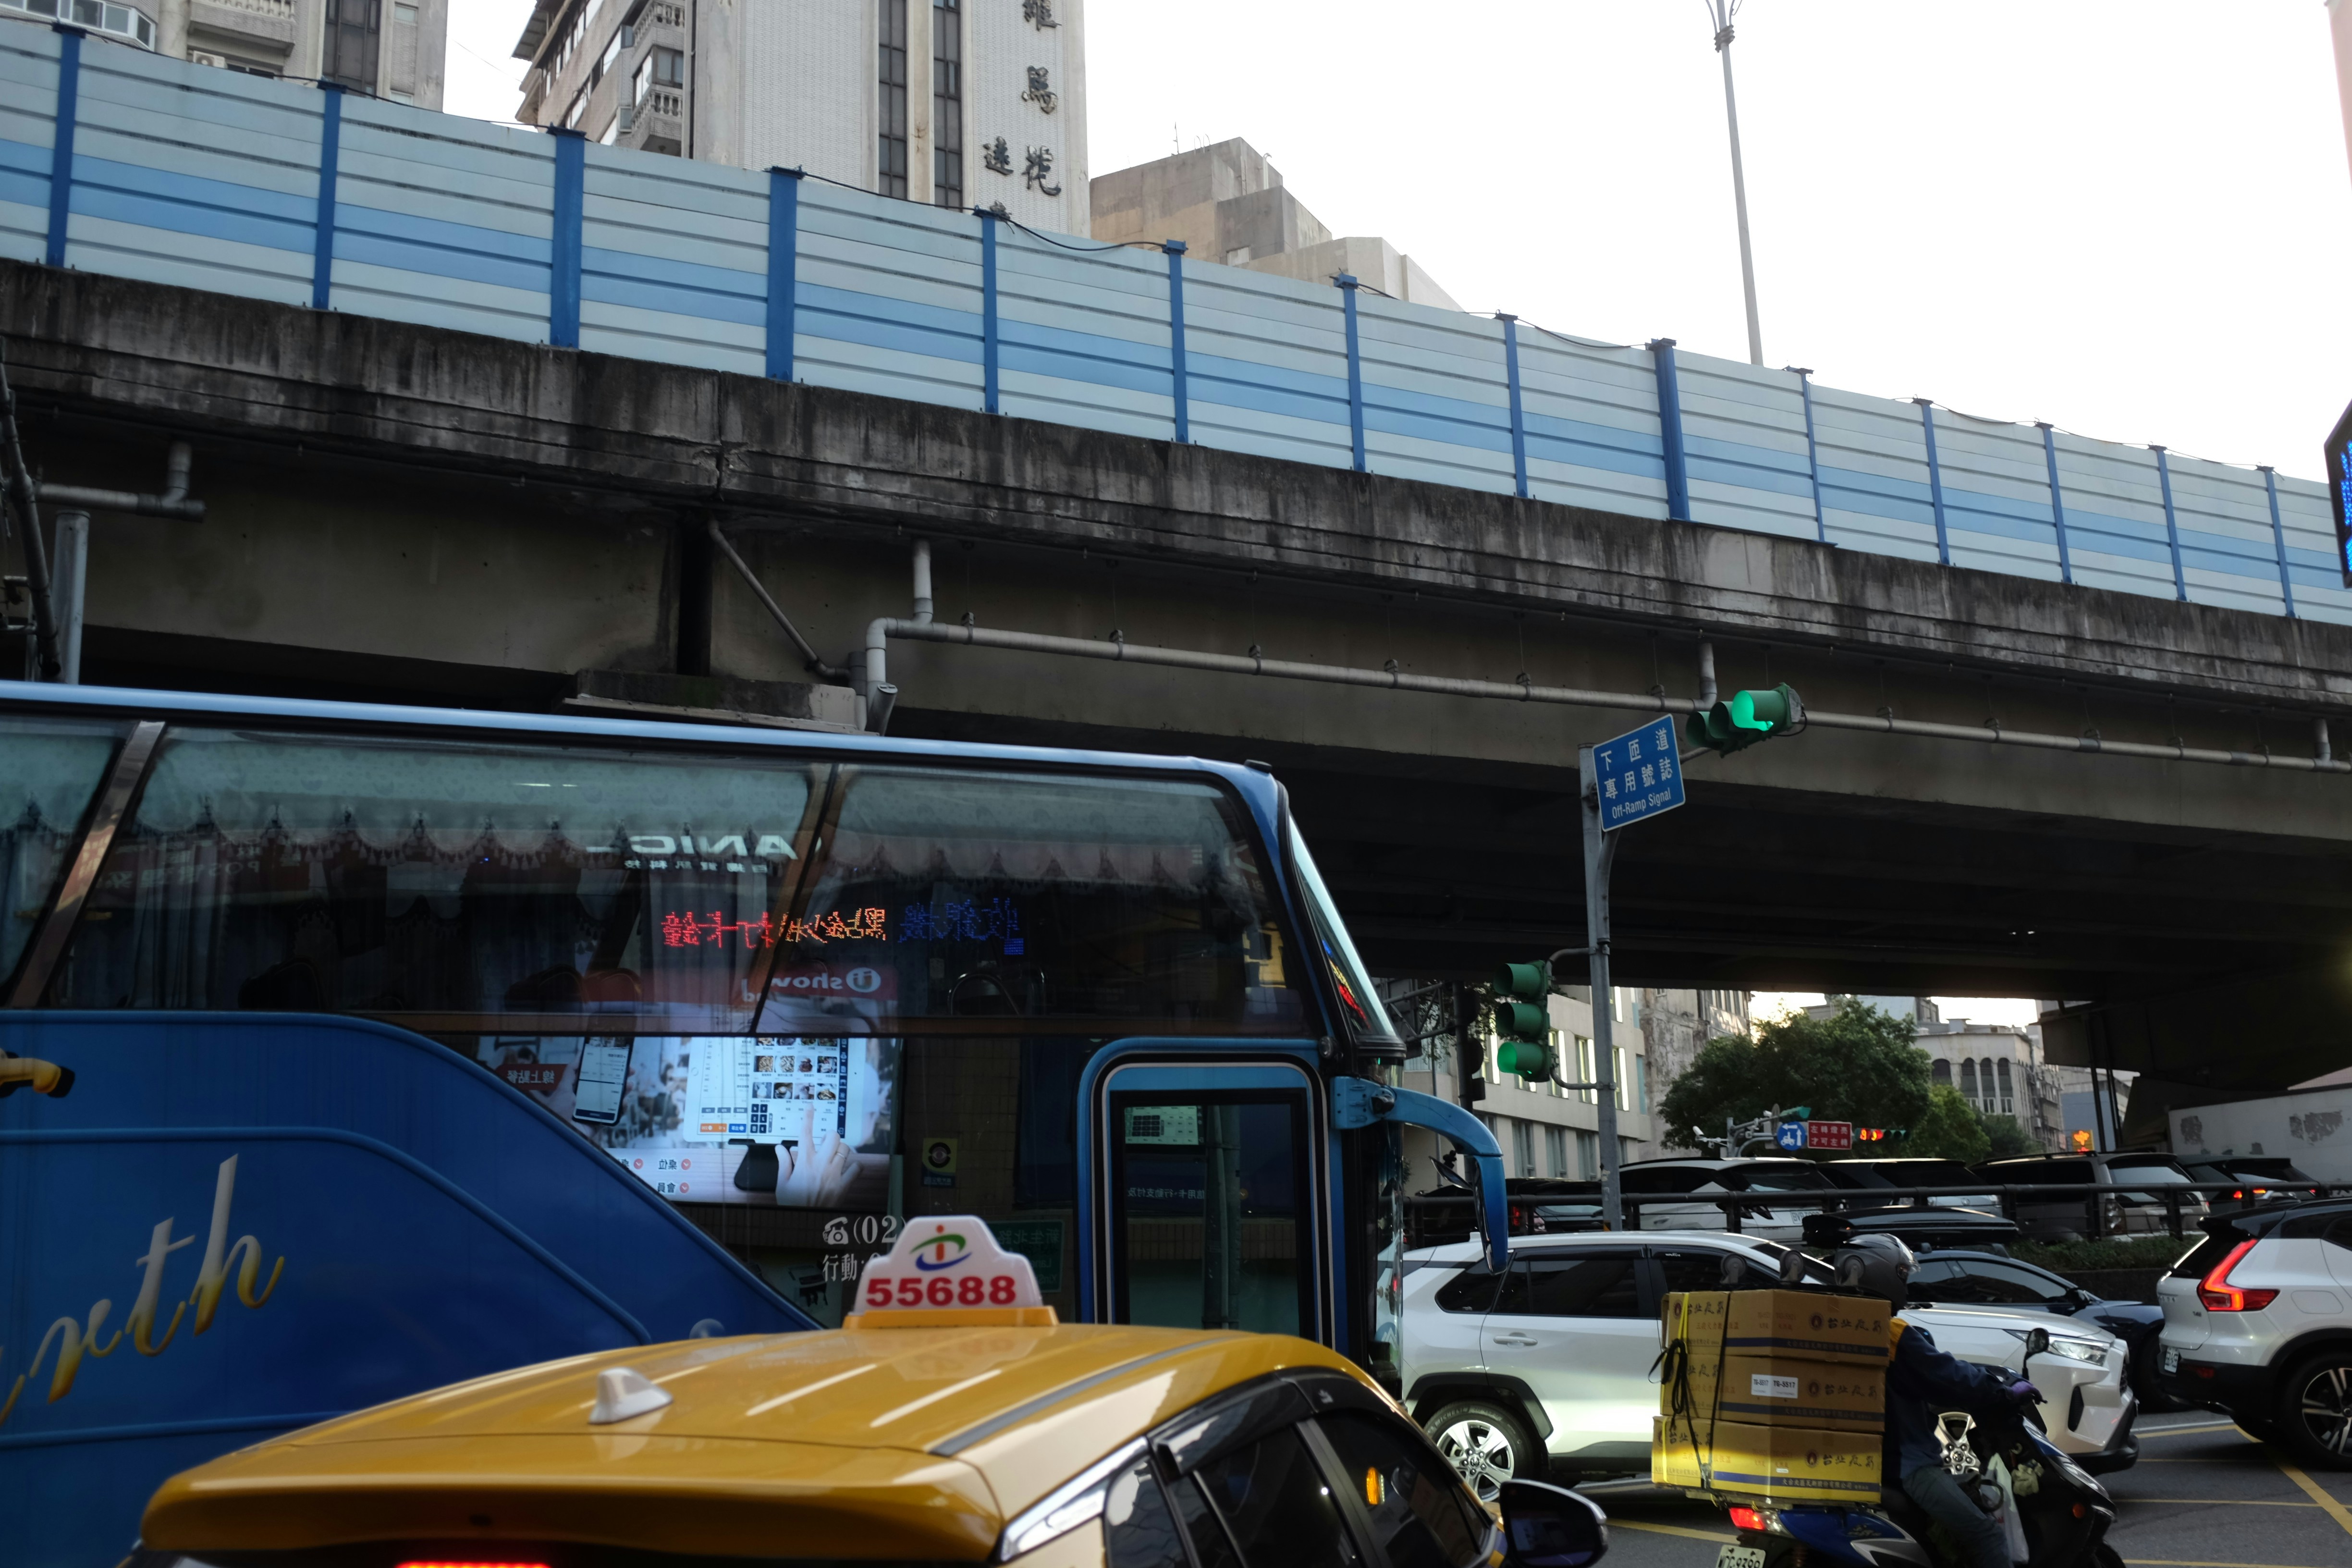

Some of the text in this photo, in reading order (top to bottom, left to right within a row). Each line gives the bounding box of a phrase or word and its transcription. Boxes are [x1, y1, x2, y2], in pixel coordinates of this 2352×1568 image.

[1600, 727, 1669, 772] 下匝道
[1604, 756, 1673, 800] 專用號誌
[1612, 787, 1672, 819] Off-Ramp Signal
[865, 1274, 1017, 1307] 55688
[1773, 1380, 1796, 1388] TG-5517
[1435, 1407, 1469, 1427] MICHELIN
